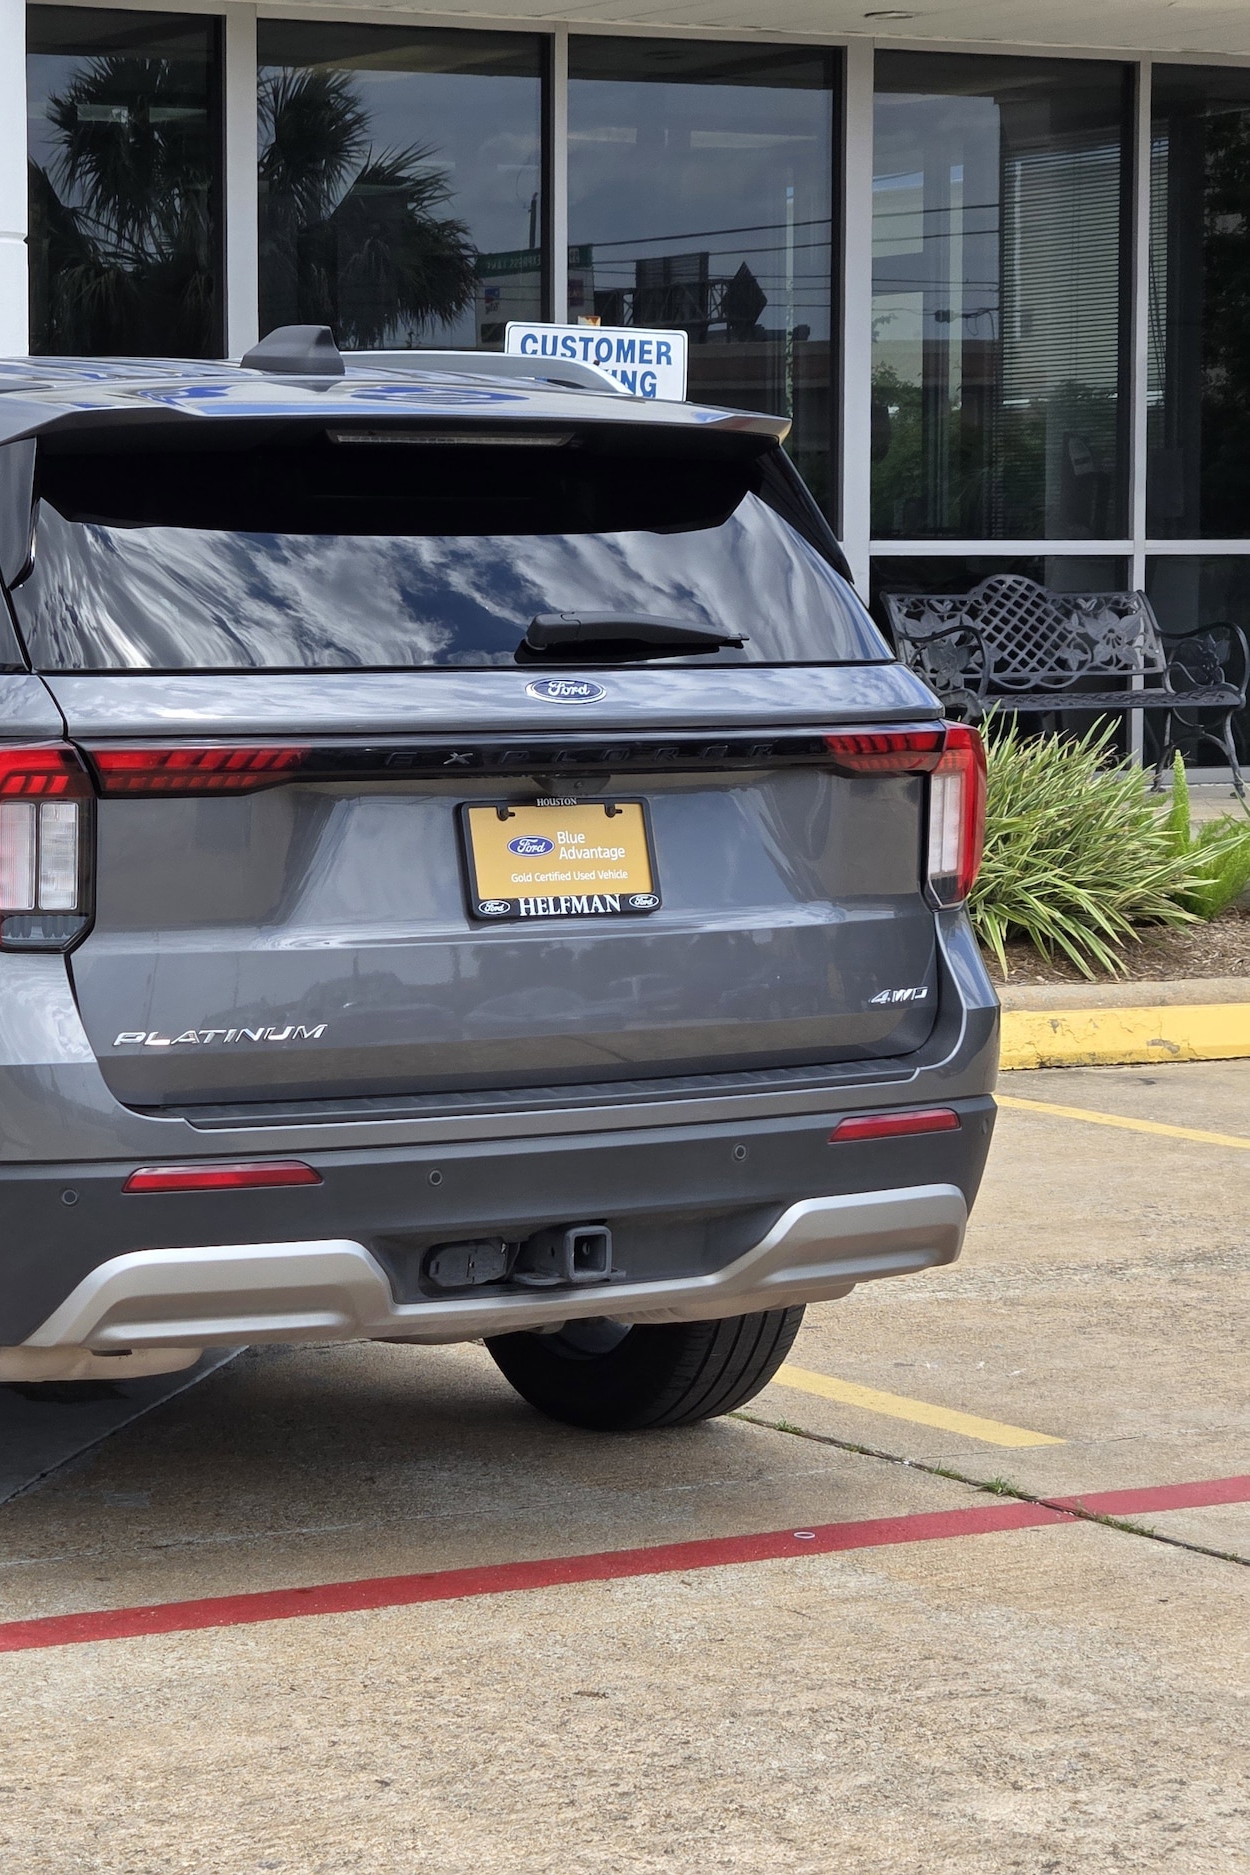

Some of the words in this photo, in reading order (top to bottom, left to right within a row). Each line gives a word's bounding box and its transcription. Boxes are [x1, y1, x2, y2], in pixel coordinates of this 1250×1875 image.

[520, 333, 673, 366] CUSTOMER
[547, 679, 590, 697] Ford
[385, 744, 775, 767] EXPLORER
[536, 797, 577, 806] HOUSTON
[517, 838, 546, 853] Ford
[557, 831, 586, 844] Blue
[559, 846, 626, 861] Advantage
[511, 873, 533, 883] Gold
[534, 871, 571, 882] Certified
[573, 870, 596, 881] Used
[598, 869, 628, 880] Vehicle
[483, 902, 505, 913] Ford
[518, 894, 621, 917] HELFMAN
[634, 896, 654, 907] Ford
[869, 986, 929, 1004] 4WD
[112, 1023, 328, 1046] PLATINUM
